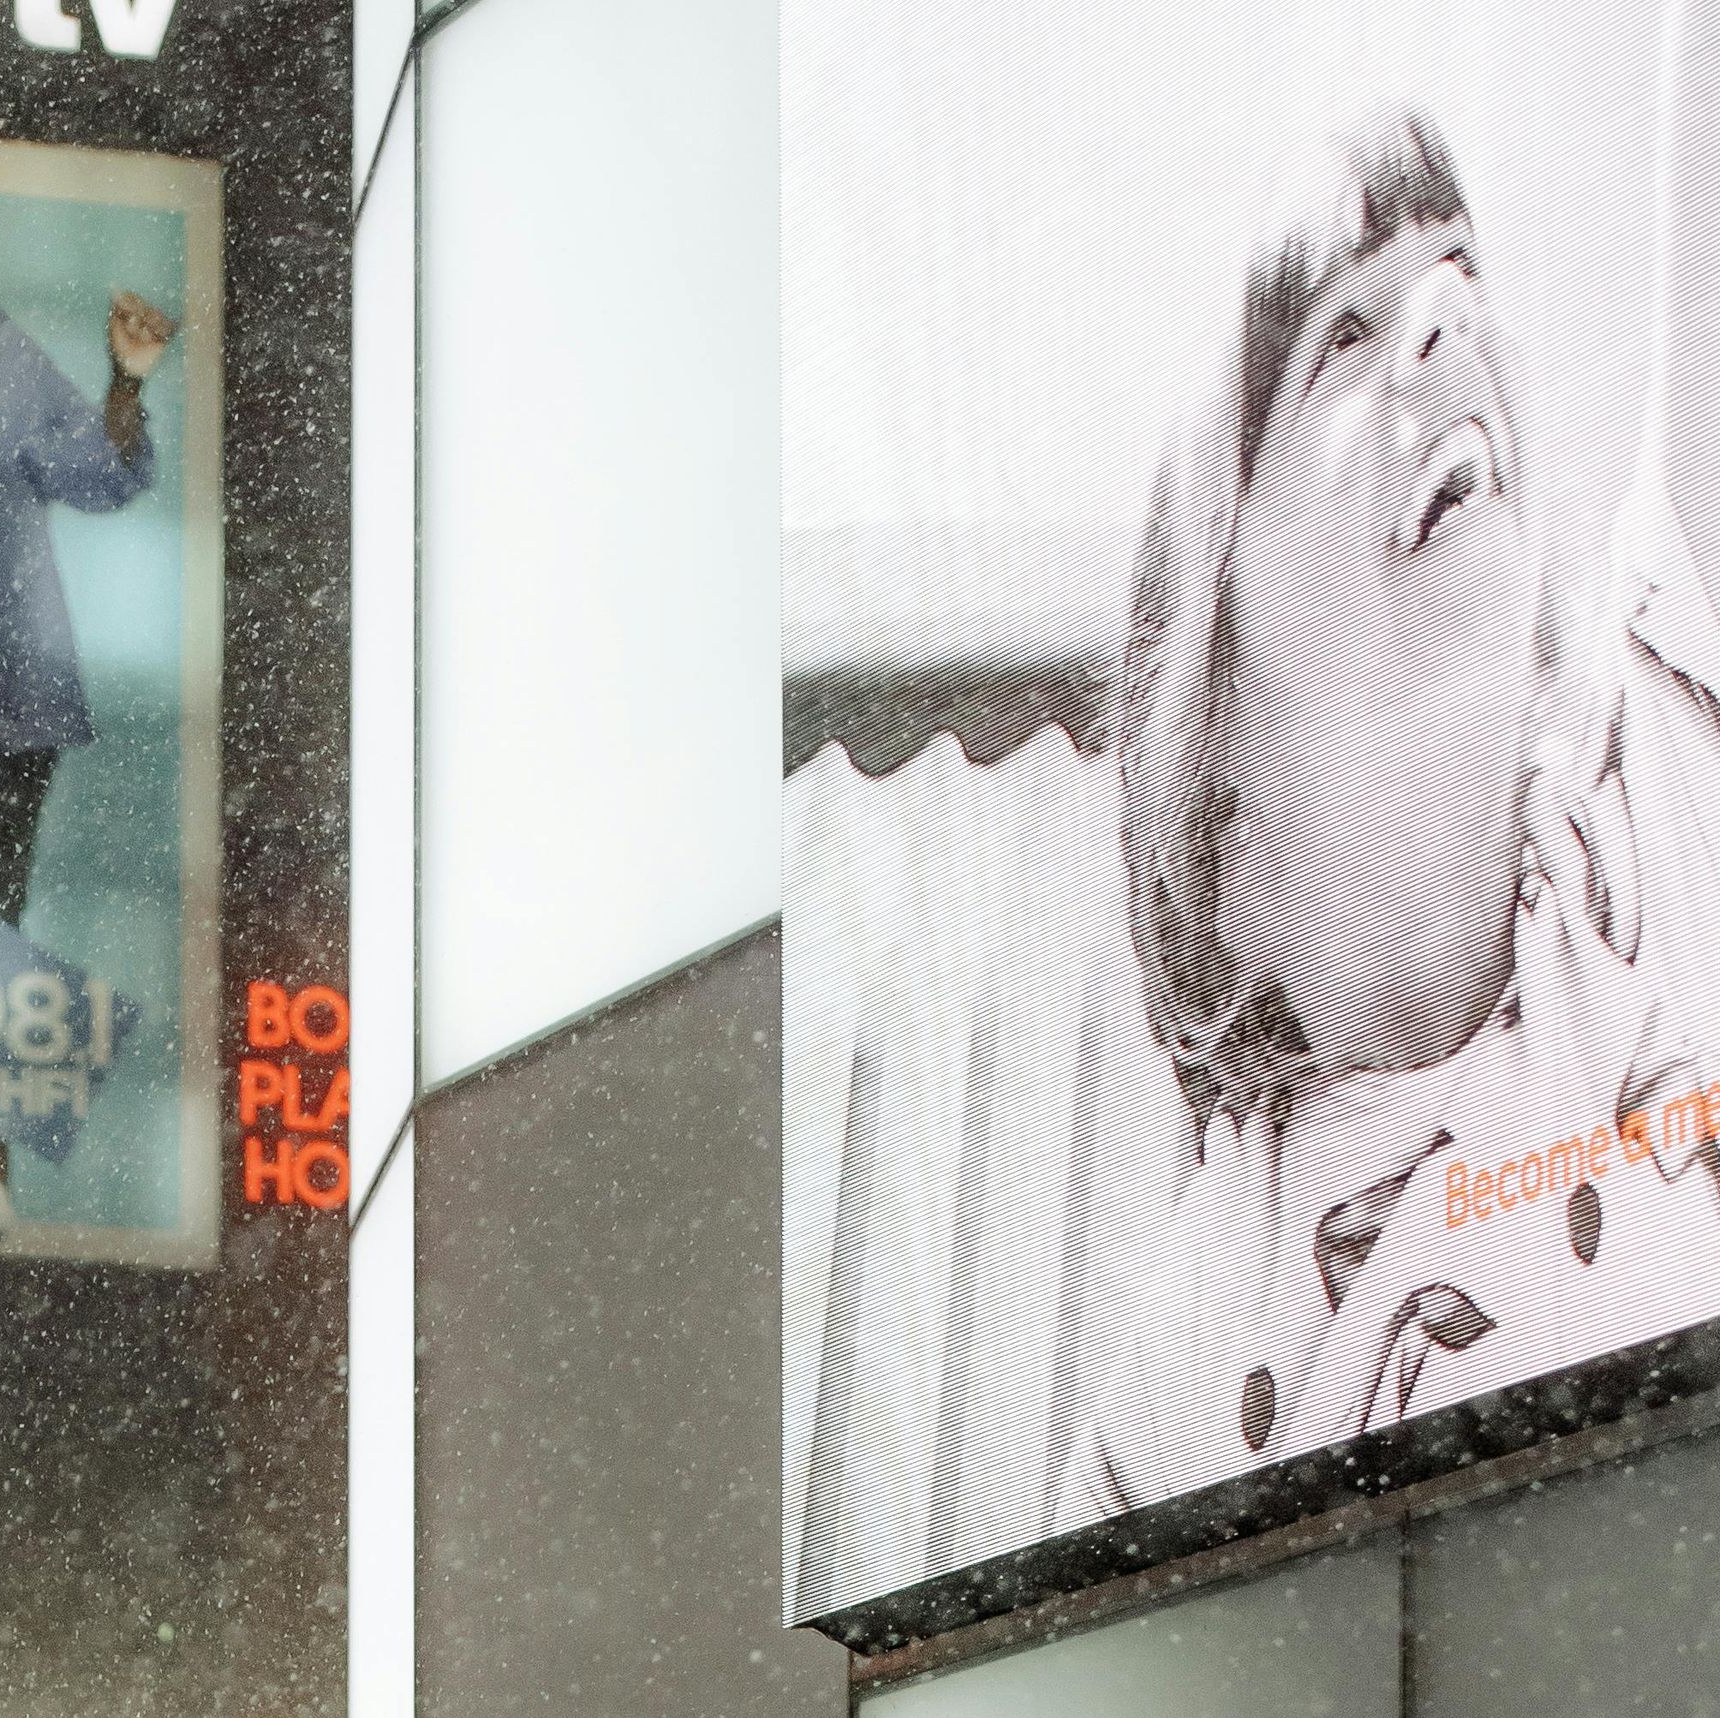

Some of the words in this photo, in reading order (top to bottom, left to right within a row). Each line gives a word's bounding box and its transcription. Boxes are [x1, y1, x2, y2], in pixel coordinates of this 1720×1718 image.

[246, 979, 350, 1054] BO
[243, 1134, 350, 1210] HO
[1445, 1125, 1612, 1230] Become
[1620, 1109, 1654, 1166] a
